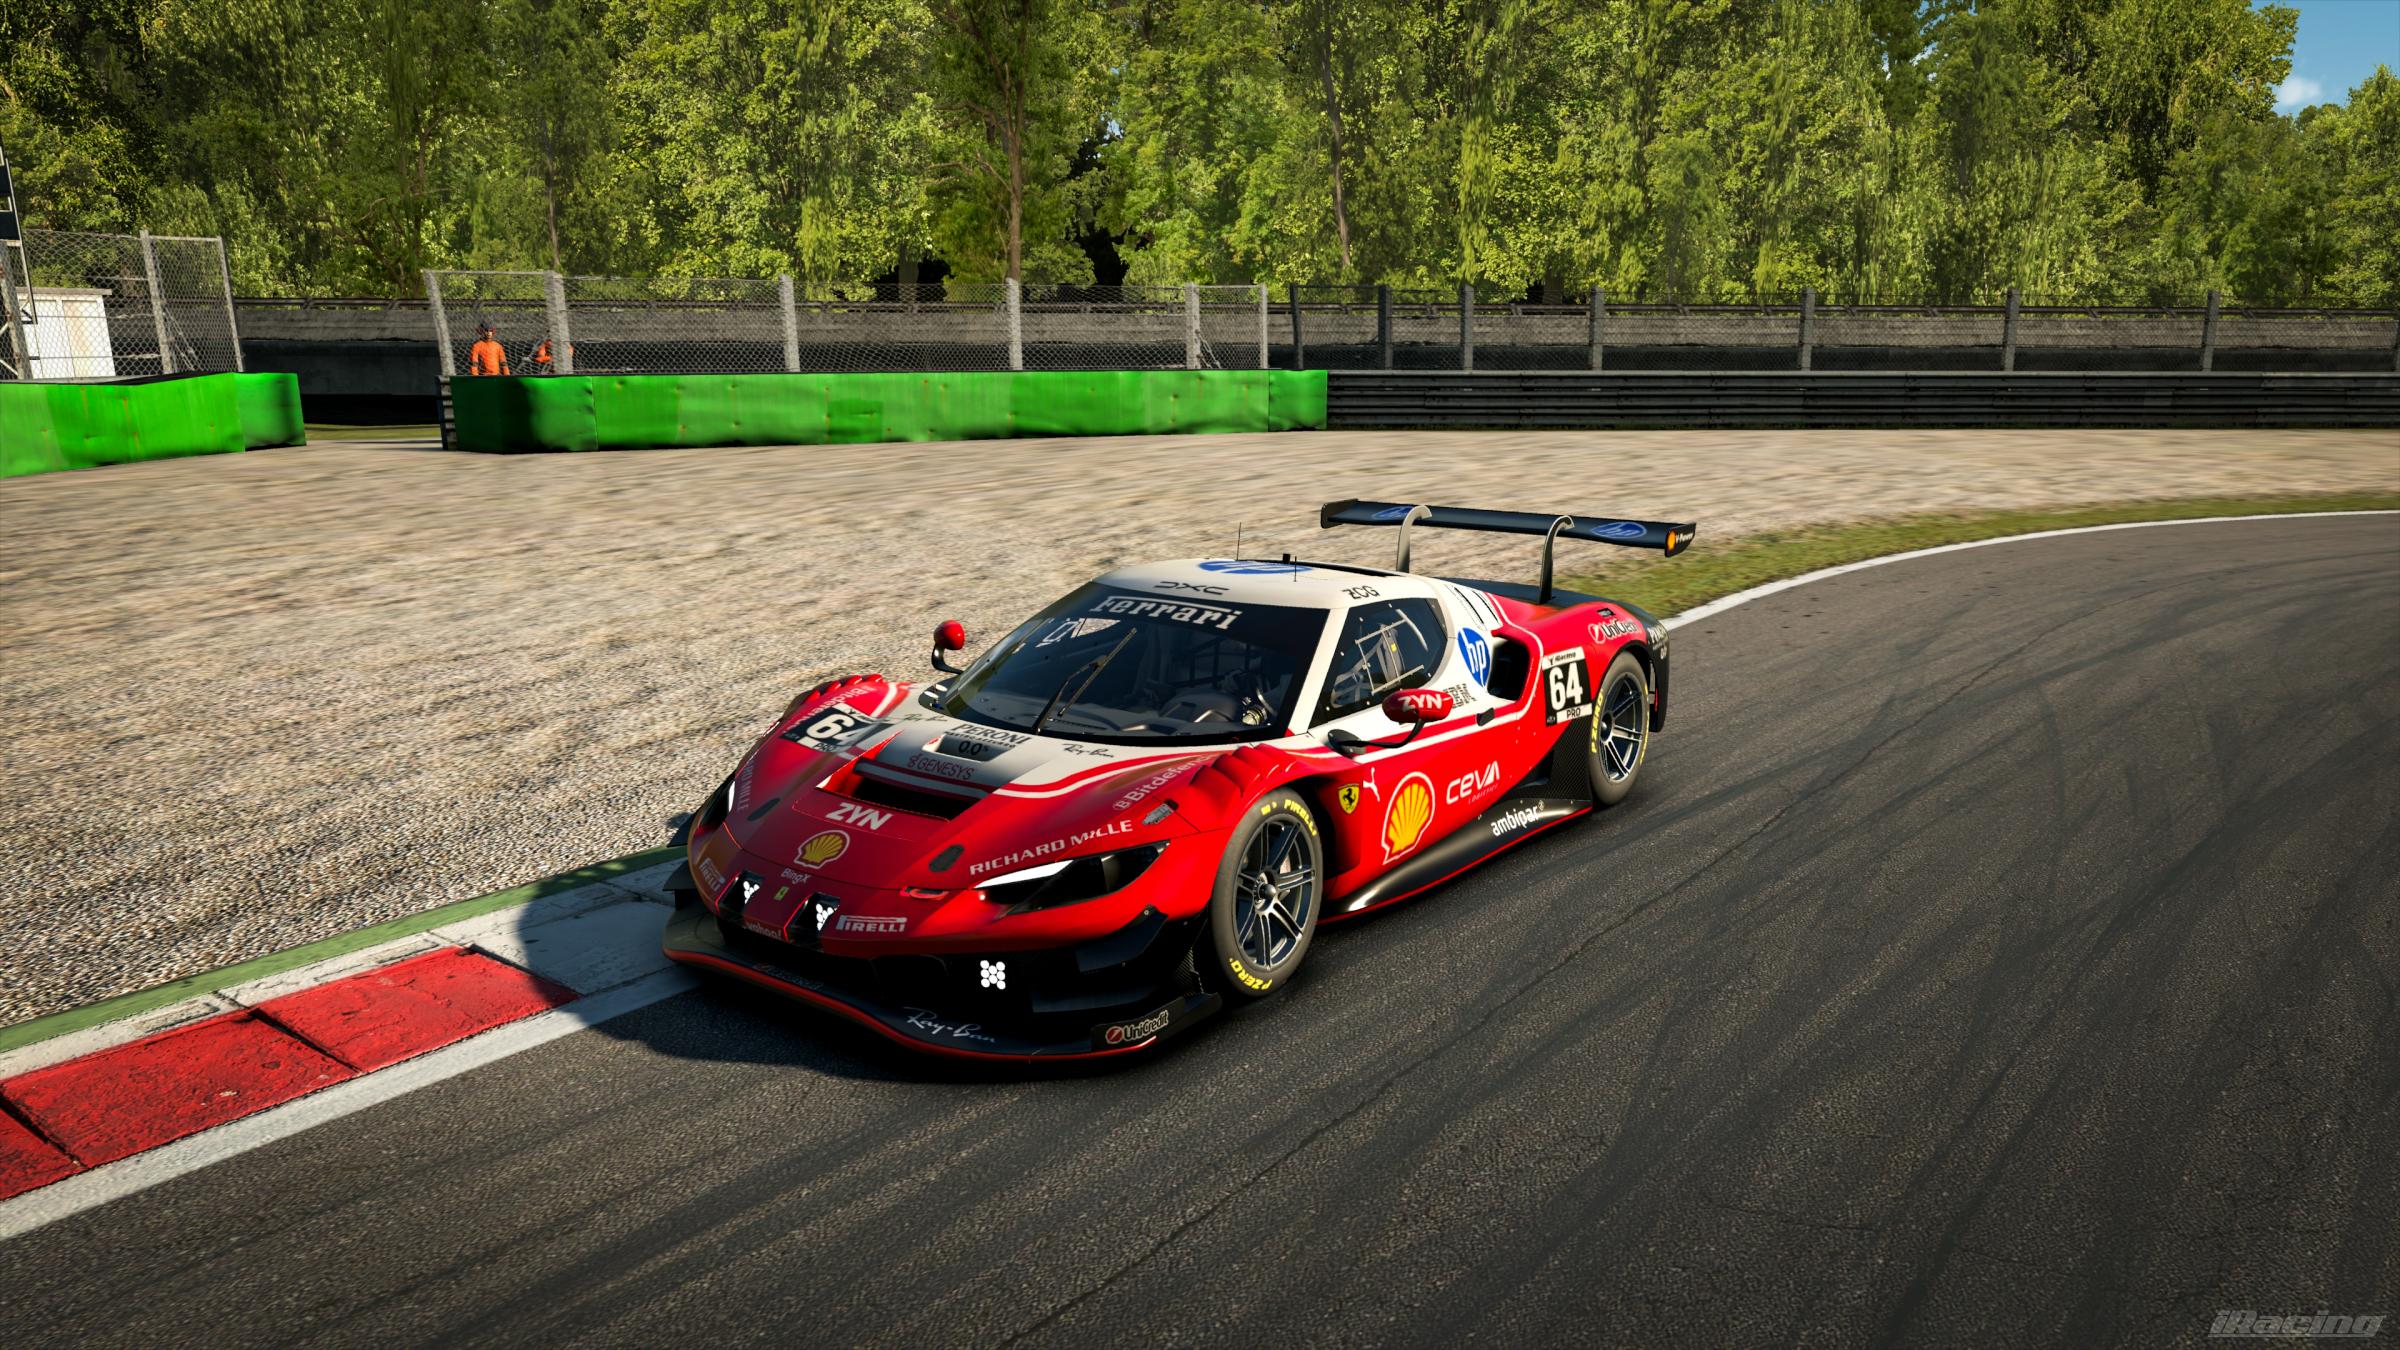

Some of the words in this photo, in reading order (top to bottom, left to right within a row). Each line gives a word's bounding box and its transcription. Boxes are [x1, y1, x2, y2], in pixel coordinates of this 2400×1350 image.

[1342, 585, 1380, 599] ZCG
[1089, 595, 1243, 630] Ferrari
[1460, 627, 1487, 687] hp
[1549, 661, 1583, 711] 64
[1397, 693, 1443, 712] ZYN
[1566, 707, 1581, 719] PRO
[951, 723, 1032, 745] PERONI
[916, 757, 976, 781] GENESYS
[825, 802, 894, 830] ZYN
[1284, 799, 1317, 836] PIRELLI
[1490, 805, 1540, 837] ambipar
[969, 838, 1066, 876] RICHARD
[1070, 819, 1134, 847] MILLE
[781, 867, 812, 885] BingX
[835, 914, 908, 932] PIRELLI
[1124, 1010, 1168, 1041] UniCredit
